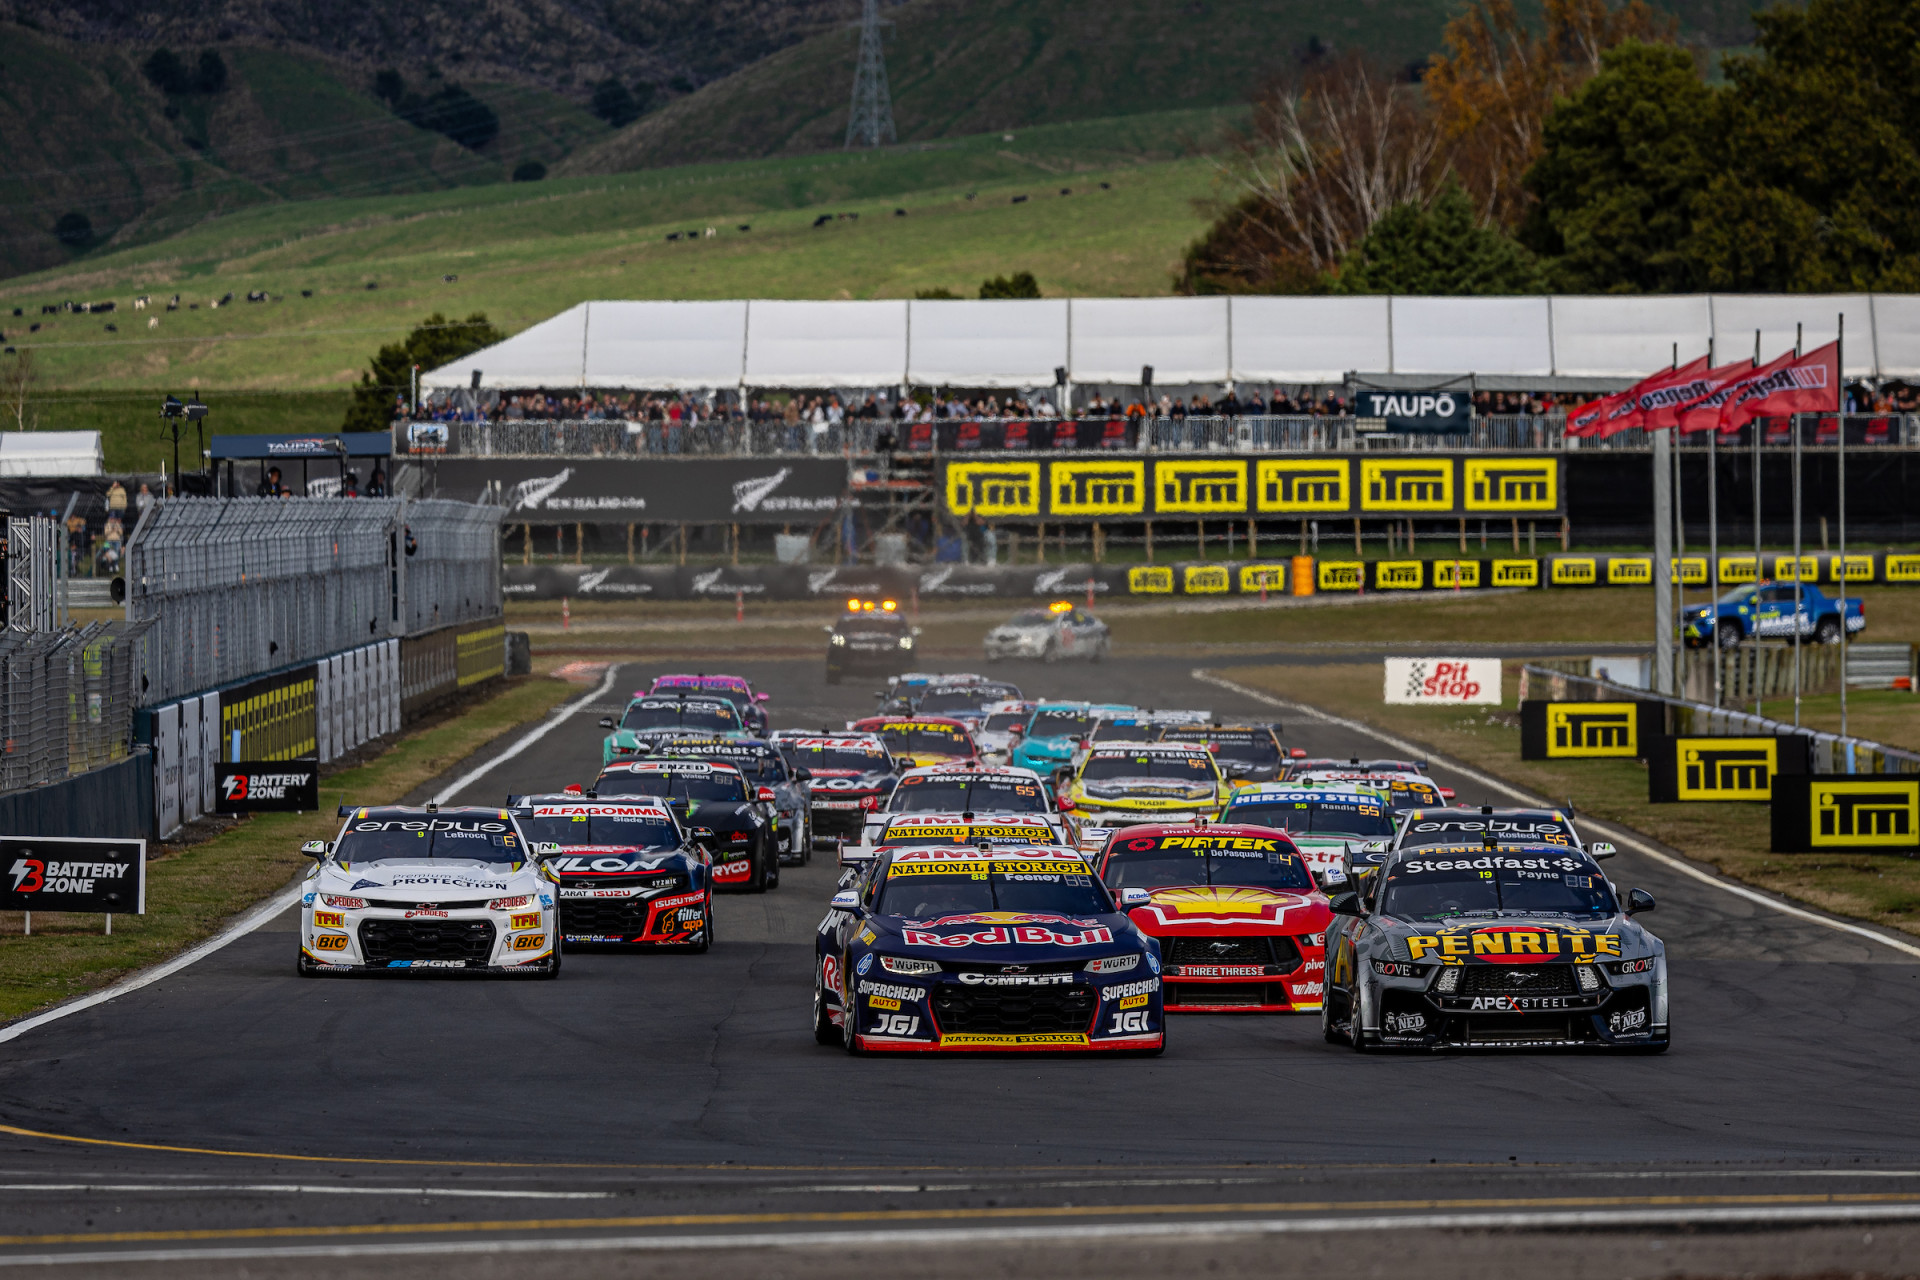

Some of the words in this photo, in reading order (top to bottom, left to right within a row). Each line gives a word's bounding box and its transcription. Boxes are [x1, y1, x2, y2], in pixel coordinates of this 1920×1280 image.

[1370, 393, 1456, 417] TAUPŌ
[1436, 663, 1468, 681] Pit
[1424, 677, 1480, 700] Stop
[883, 724, 955, 733] PIRTEK
[663, 745, 749, 755] Steadfast
[1130, 751, 1207, 759] BATTERIES
[248, 773, 310, 787] BATTERY
[979, 775, 1033, 784] ASSIST
[247, 786, 286, 799] ZONE
[1236, 794, 1321, 804] HERZOG
[1325, 793, 1380, 806] STEEL
[534, 807, 668, 817] ALFAGOMMA
[1321, 803, 1356, 811] Randle
[1358, 804, 1380, 816] 55
[355, 819, 507, 832] erebus
[613, 816, 643, 824] Slade
[895, 816, 1043, 826] AMPOL
[1414, 819, 1562, 833] erebus
[444, 831, 487, 840] LeBrocq
[889, 828, 964, 837] NATIONAL
[973, 828, 1046, 837] STORAGE
[1498, 831, 1540, 839] Kostecki
[990, 836, 1028, 844] Brown
[1160, 837, 1279, 851] PIRTEK
[899, 849, 1077, 860] AMPOL
[1419, 846, 1521, 855] PENRITE
[46, 861, 130, 878] BATTERY
[712, 861, 749, 876] RYCO
[892, 863, 984, 875] NATIONAL
[995, 862, 1083, 874] STORAGE
[1406, 857, 1550, 874] Steadfast
[1006, 874, 1060, 882] Feeney
[1479, 871, 1493, 879] 19
[1517, 871, 1559, 879] Payne
[43, 878, 95, 894] ZONE
[393, 878, 507, 890] PROTECTION
[334, 896, 363, 908] PEDDERS
[499, 896, 528, 907] PEDDERS
[655, 897, 683, 908] ISUZU
[316, 913, 341, 925] TFH
[415, 910, 448, 918] PEDDERS
[513, 915, 538, 926] TFH
[683, 920, 703, 931] app
[903, 927, 1010, 948] Red
[1014, 926, 1113, 947] Bull
[1407, 932, 1622, 960] PENRITE
[1187, 966, 1218, 976] THREE
[1220, 966, 1258, 976] THREES
[1375, 961, 1411, 977] GROVE
[1622, 959, 1652, 974] GROVE
[958, 973, 1073, 985] COMPLETE
[858, 979, 926, 1002] SUPERCHEAP
[1102, 976, 1160, 1002] SUPERCHEAP
[872, 998, 897, 1008] AUTO
[1122, 997, 1145, 1007] AUTO
[1471, 995, 1519, 1010] APEX
[1522, 998, 1568, 1008] STEEL
[870, 1014, 919, 1035] JGI
[1108, 1011, 1149, 1033] JGI
[1398, 1016, 1424, 1029] NED
[1622, 1011, 1645, 1028] NED
[944, 1034, 1013, 1043] NATIONAL
[1019, 1034, 1082, 1043] STORAGE
